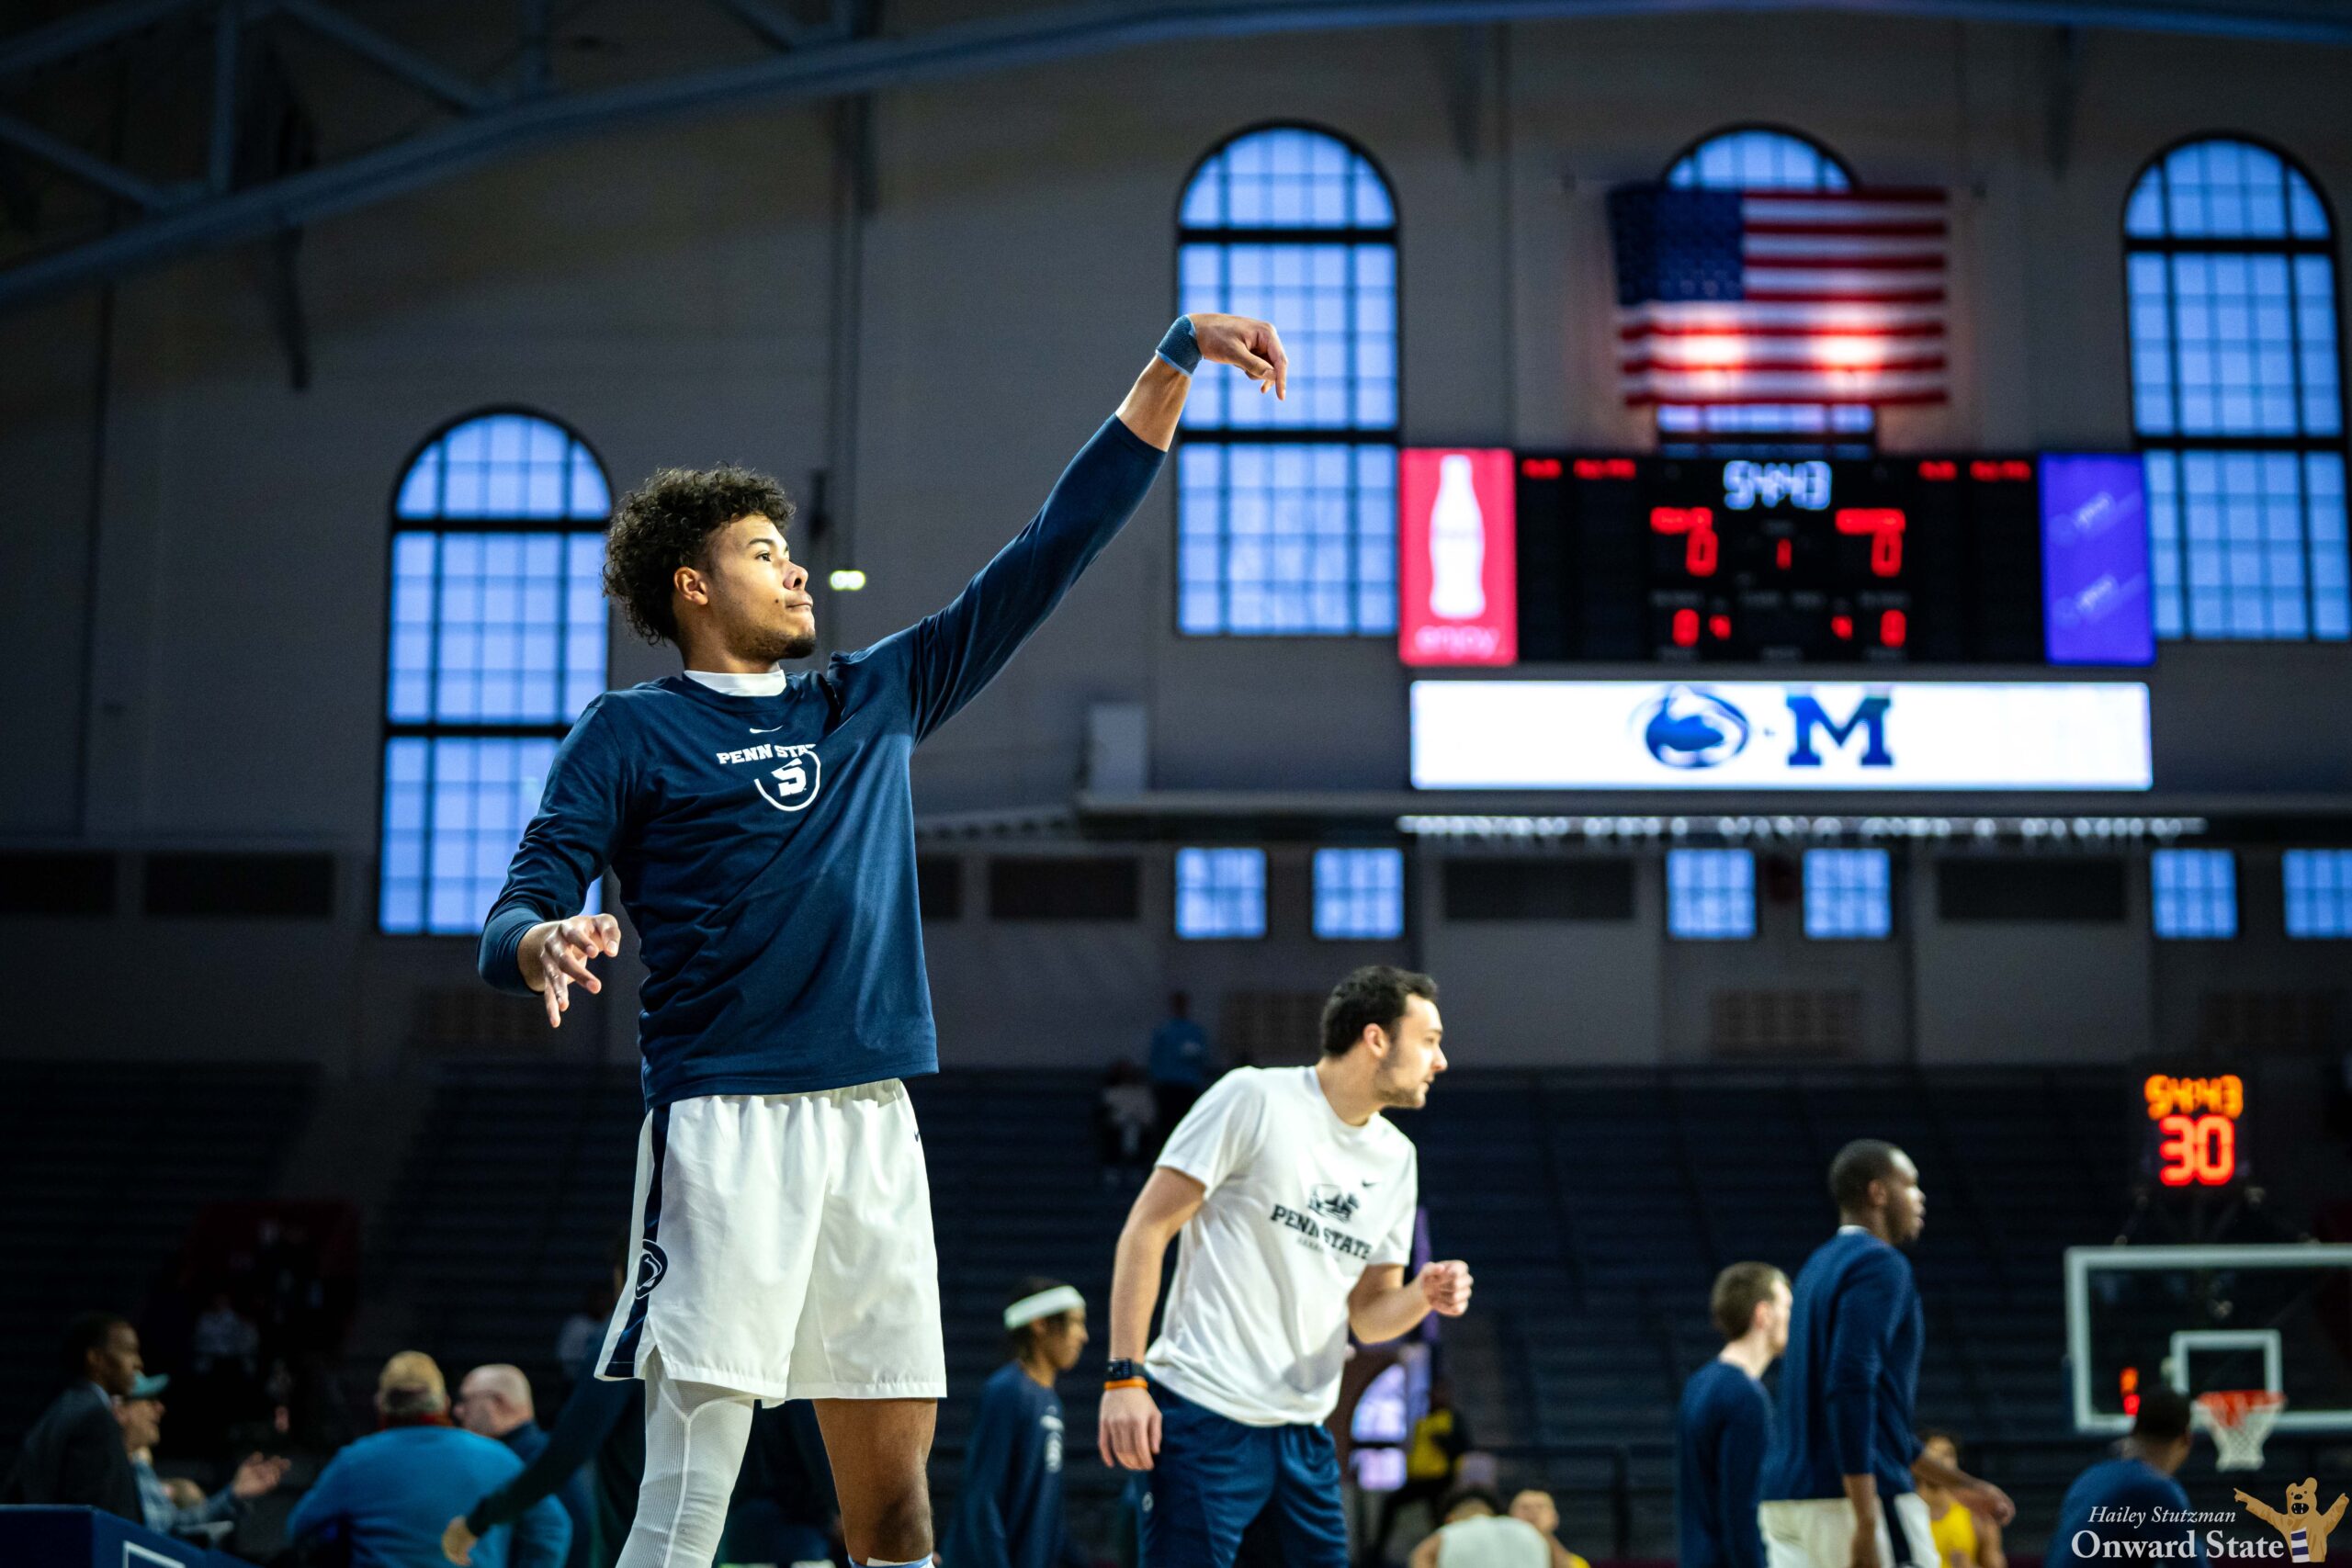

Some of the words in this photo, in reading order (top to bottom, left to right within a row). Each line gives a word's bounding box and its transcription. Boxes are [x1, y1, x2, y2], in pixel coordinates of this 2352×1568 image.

[717, 744, 773, 764] PENN
[775, 744, 816, 758] STA
[1787, 695, 1893, 766] M
[2160, 1115, 2234, 1186] 30
